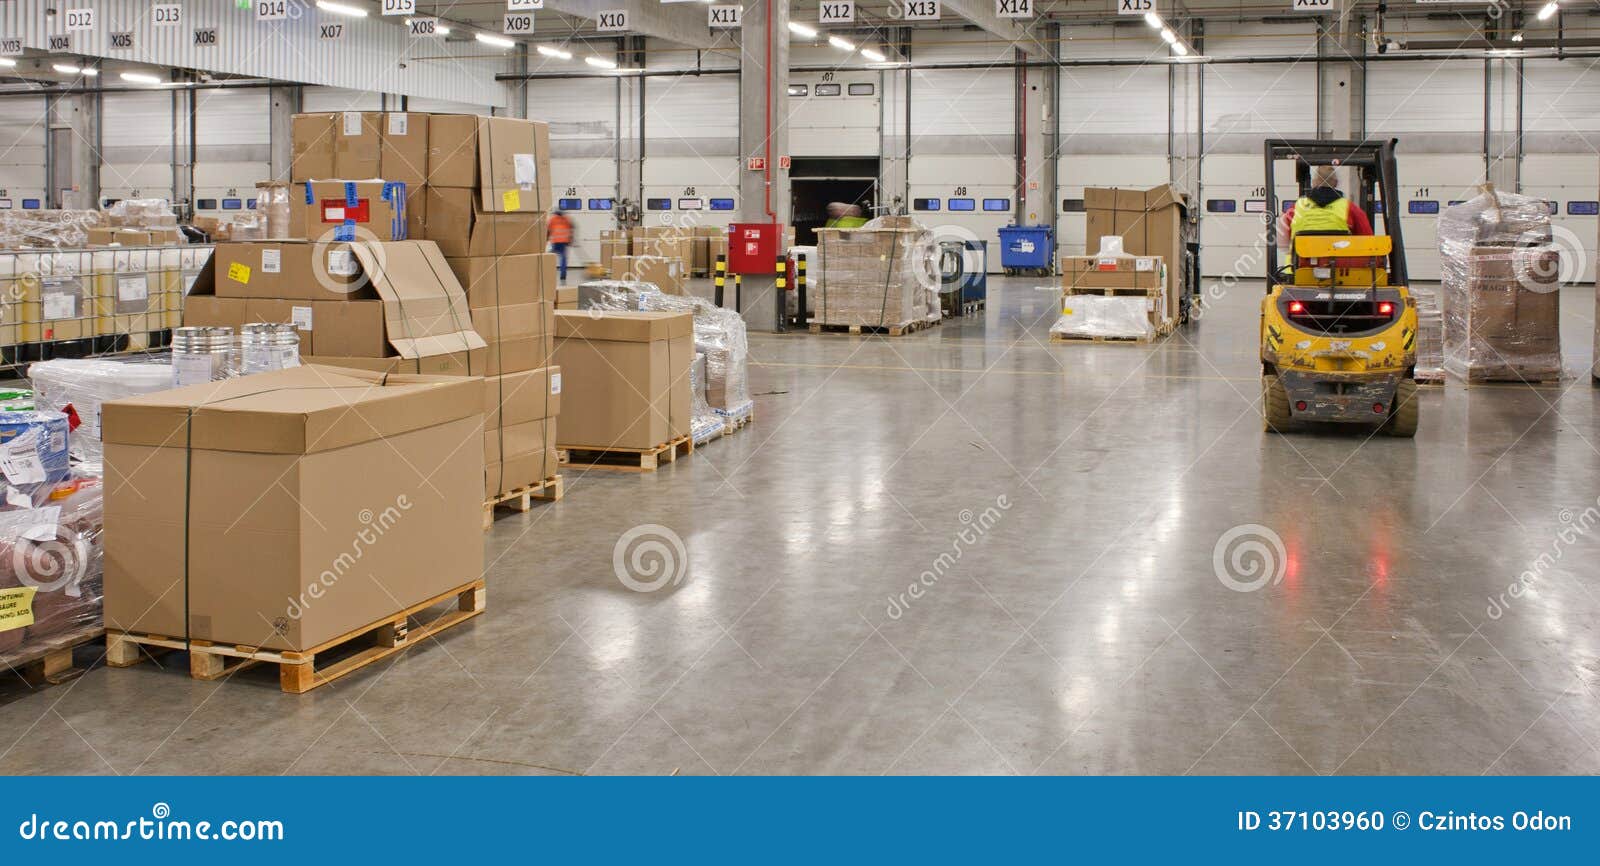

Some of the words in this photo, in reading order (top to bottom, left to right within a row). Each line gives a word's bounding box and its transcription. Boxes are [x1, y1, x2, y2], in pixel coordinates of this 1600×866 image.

[260, 2, 284, 16] D14
[386, 0, 412, 10] D15
[823, 5, 850, 18] X12
[908, 2, 936, 16] X13
[1000, 0, 1028, 13] X14
[1122, 0, 1152, 10] X15
[68, 12, 92, 26] D12
[156, 8, 180, 22] D13
[600, 14, 625, 27] X10
[712, 9, 737, 22] X11
[411, 20, 435, 34] X08
[506, 17, 531, 30] X09
[194, 30, 215, 44] X06
[320, 25, 342, 39] X07
[2, 39, 21, 52] X03
[50, 36, 70, 50] X04
[111, 34, 132, 47] X05
